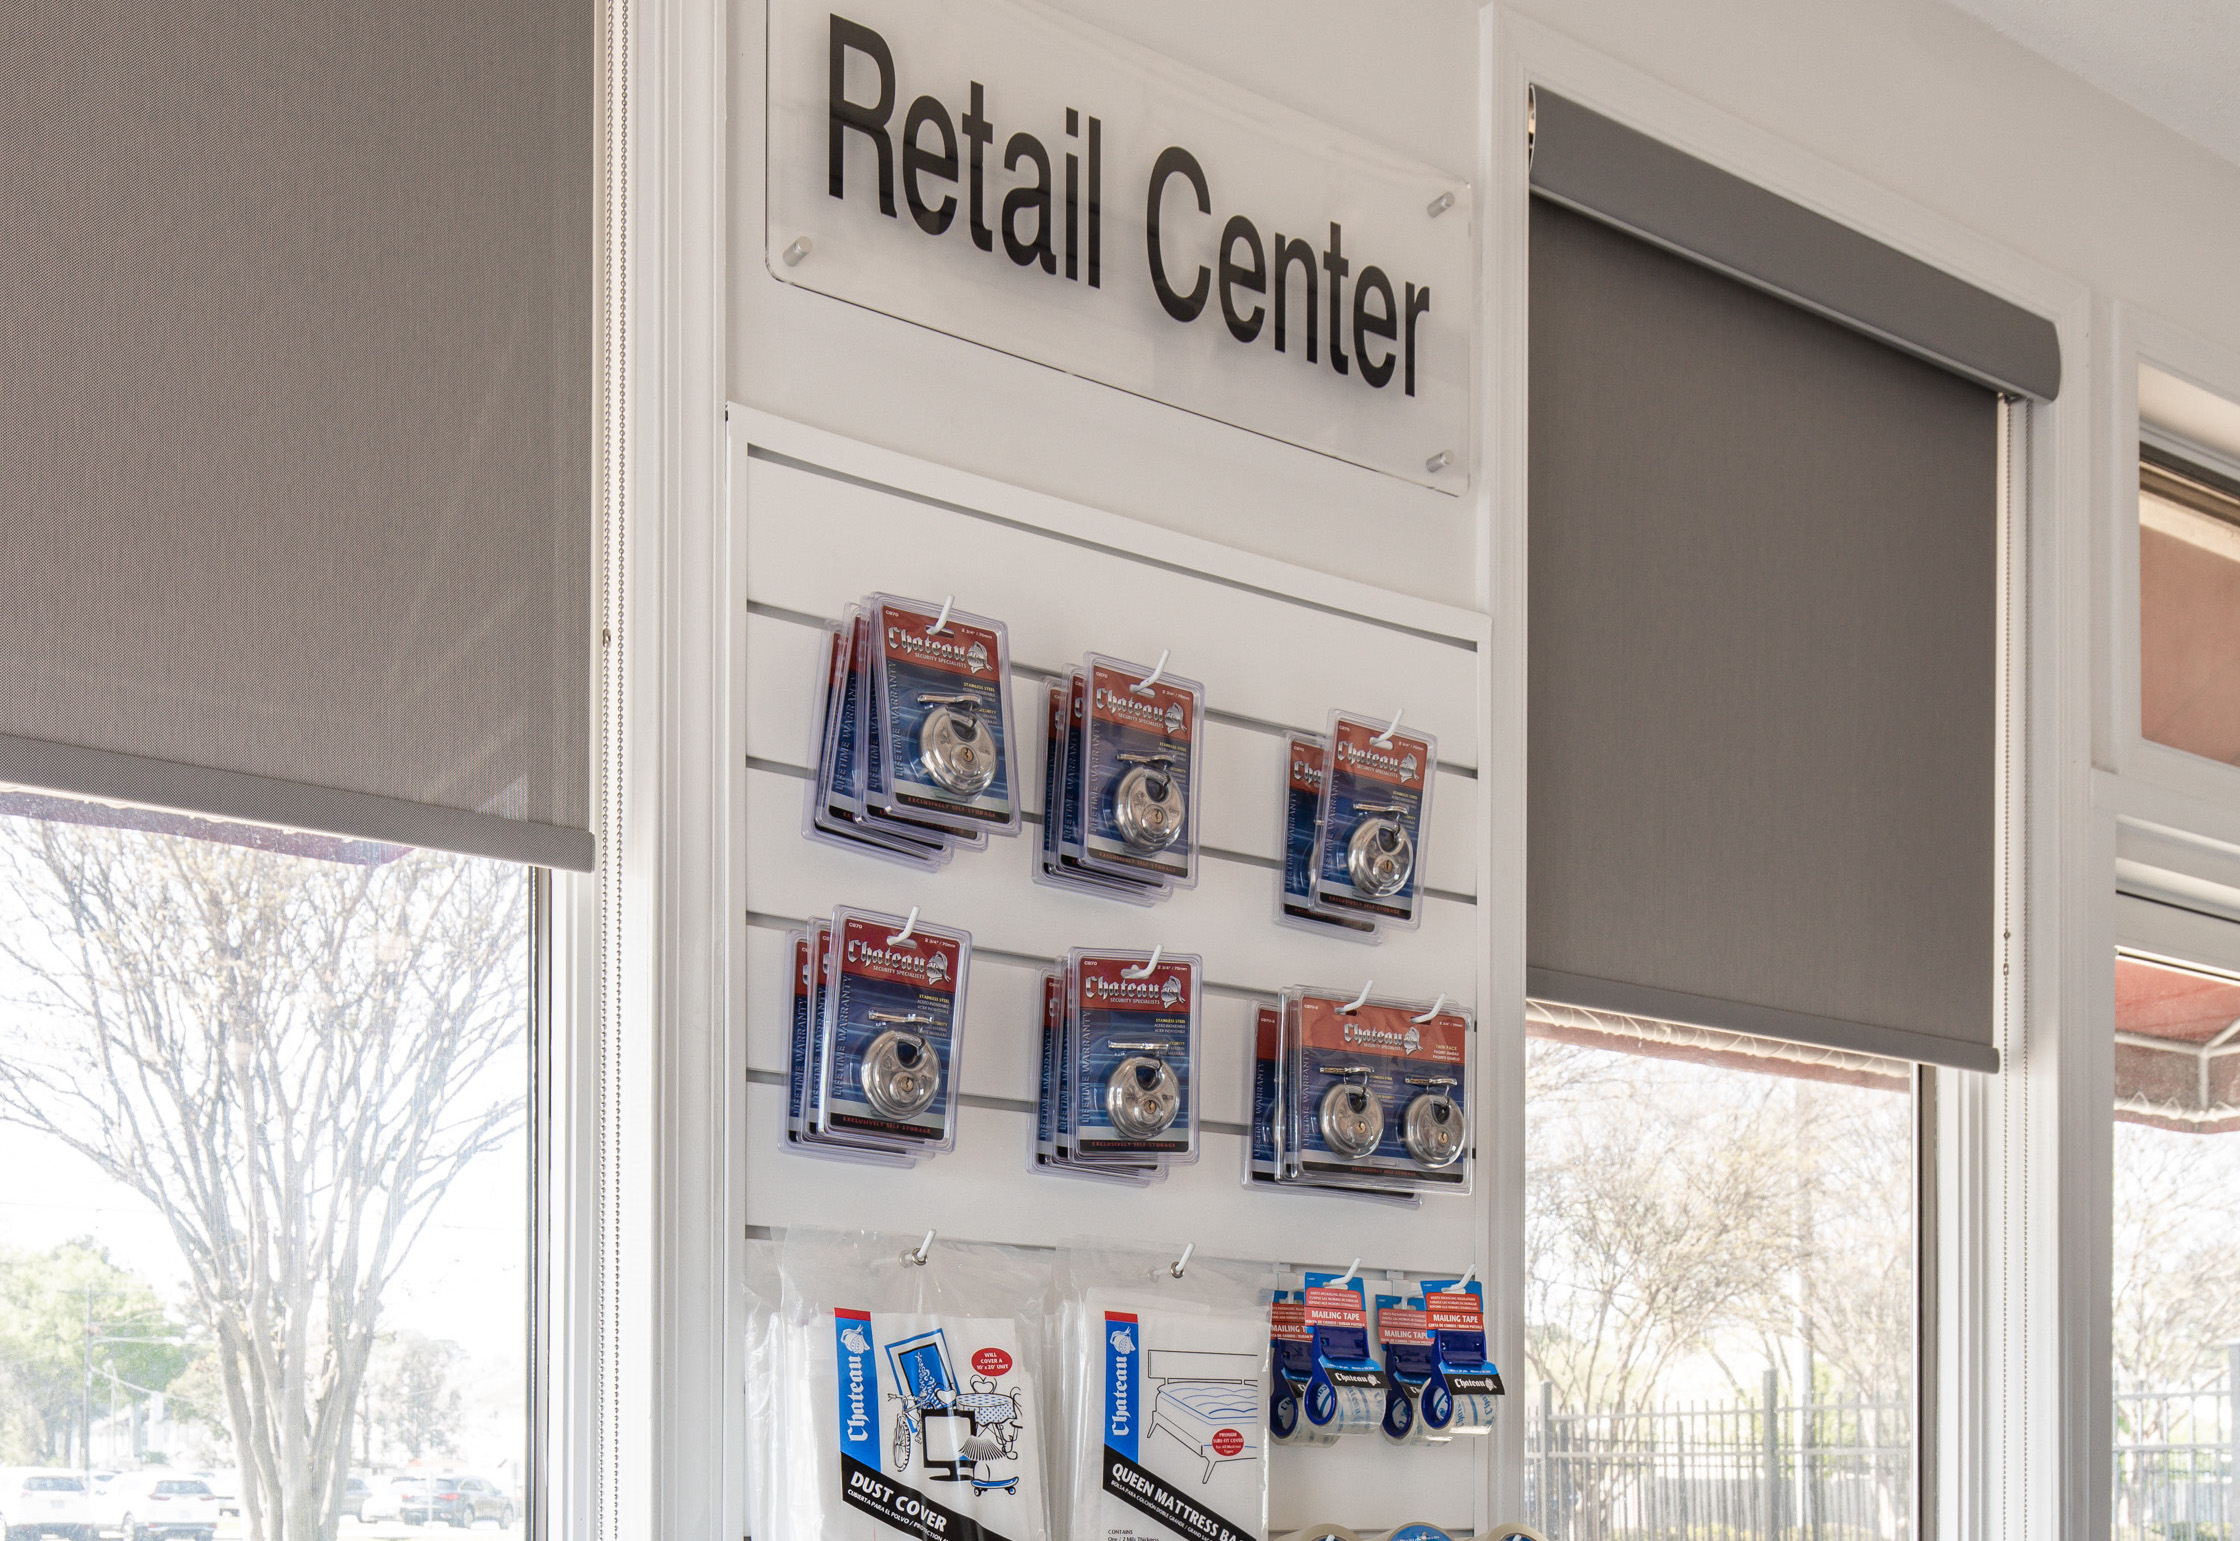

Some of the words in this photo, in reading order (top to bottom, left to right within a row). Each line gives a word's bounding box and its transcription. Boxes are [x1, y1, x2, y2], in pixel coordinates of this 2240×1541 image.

[828, 13, 1101, 289] Retail
[1147, 146, 1430, 397] Center
[888, 626, 966, 662] Chateau
[914, 652, 937, 662] SECURITY
[938, 657, 967, 668] SPECIALISTS
[887, 660, 901, 724] WARRANTY
[1096, 688, 1164, 722] Chateau
[1118, 713, 1138, 722] SECURITY
[1138, 717, 1164, 729] SPECIALISTS
[835, 742, 850, 791] LIFETIME
[870, 739, 879, 789] LIFETIME
[892, 728, 905, 777] LIFETIME
[1066, 731, 1078, 790] WARRANTY
[1091, 722, 1100, 782] WARRANTY
[1338, 740, 1399, 772] Chateau
[1356, 764, 1375, 773] SECURITY
[1376, 768, 1398, 778] SPECIALISTS
[907, 797, 949, 809] EXCLUSIVELY
[1064, 793, 1074, 841] LIFETIME
[1090, 786, 1099, 833] LIFETIME
[1288, 792, 1297, 845] WARRANTY
[1327, 773, 1340, 830] WARRANTY
[1286, 848, 1294, 889] LIFETIME
[1322, 833, 1334, 878] LIFETIME
[848, 939, 926, 973] Chateau
[873, 965, 895, 974] SECURITY
[896, 969, 925, 980] SPECIALISTS
[838, 976, 852, 1043] WARRANTY
[919, 994, 938, 1002] STAINLESS
[1085, 975, 1160, 1001] Chateau
[796, 998, 807, 1063] WARRANTY
[1082, 1010, 1092, 1072] WARRANTY
[1343, 1023, 1403, 1046] Chateau
[793, 1065, 804, 1114] LIFETIME
[812, 1056, 821, 1105] LIFETIME
[834, 1045, 846, 1096] LIFETIME
[1255, 1063, 1265, 1114] WARRANTY
[1303, 1049, 1311, 1103] WARRANTY
[842, 1116, 884, 1127] EXCLUSIVELY
[1040, 1092, 1048, 1139] LIFETIME
[1060, 1084, 1068, 1131] LIFETIME
[1081, 1076, 1090, 1123] LIFETIME
[1254, 1117, 1263, 1157] LIFETIME
[1271, 1324, 1300, 1333] MAILING
[1311, 1310, 1342, 1320] MAILING
[1343, 1312, 1360, 1321] TAPE
[1384, 1329, 1412, 1338] MAILING
[1432, 1314, 1461, 1323] MAILING
[1462, 1315, 1479, 1324] TAPE
[847, 1355, 870, 1442] Chateau
[1111, 1356, 1131, 1436] Chateau
[1335, 1372, 1368, 1383] Chateau
[1454, 1378, 1486, 1389] Chateau
[847, 1489, 871, 1505] CUBIERTA
[870, 1501, 885, 1513] PARA
[890, 1511, 909, 1524] POLVO
[850, 1471, 894, 1503] DUST
[895, 1496, 947, 1532] COVER
[1110, 1480, 1125, 1492] BOLSA
[1125, 1488, 1136, 1498] PARA
[1187, 1526, 1202, 1538] GRAND
[1112, 1463, 1155, 1497] QUEEN
[1154, 1488, 1219, 1537] MATTRESS
